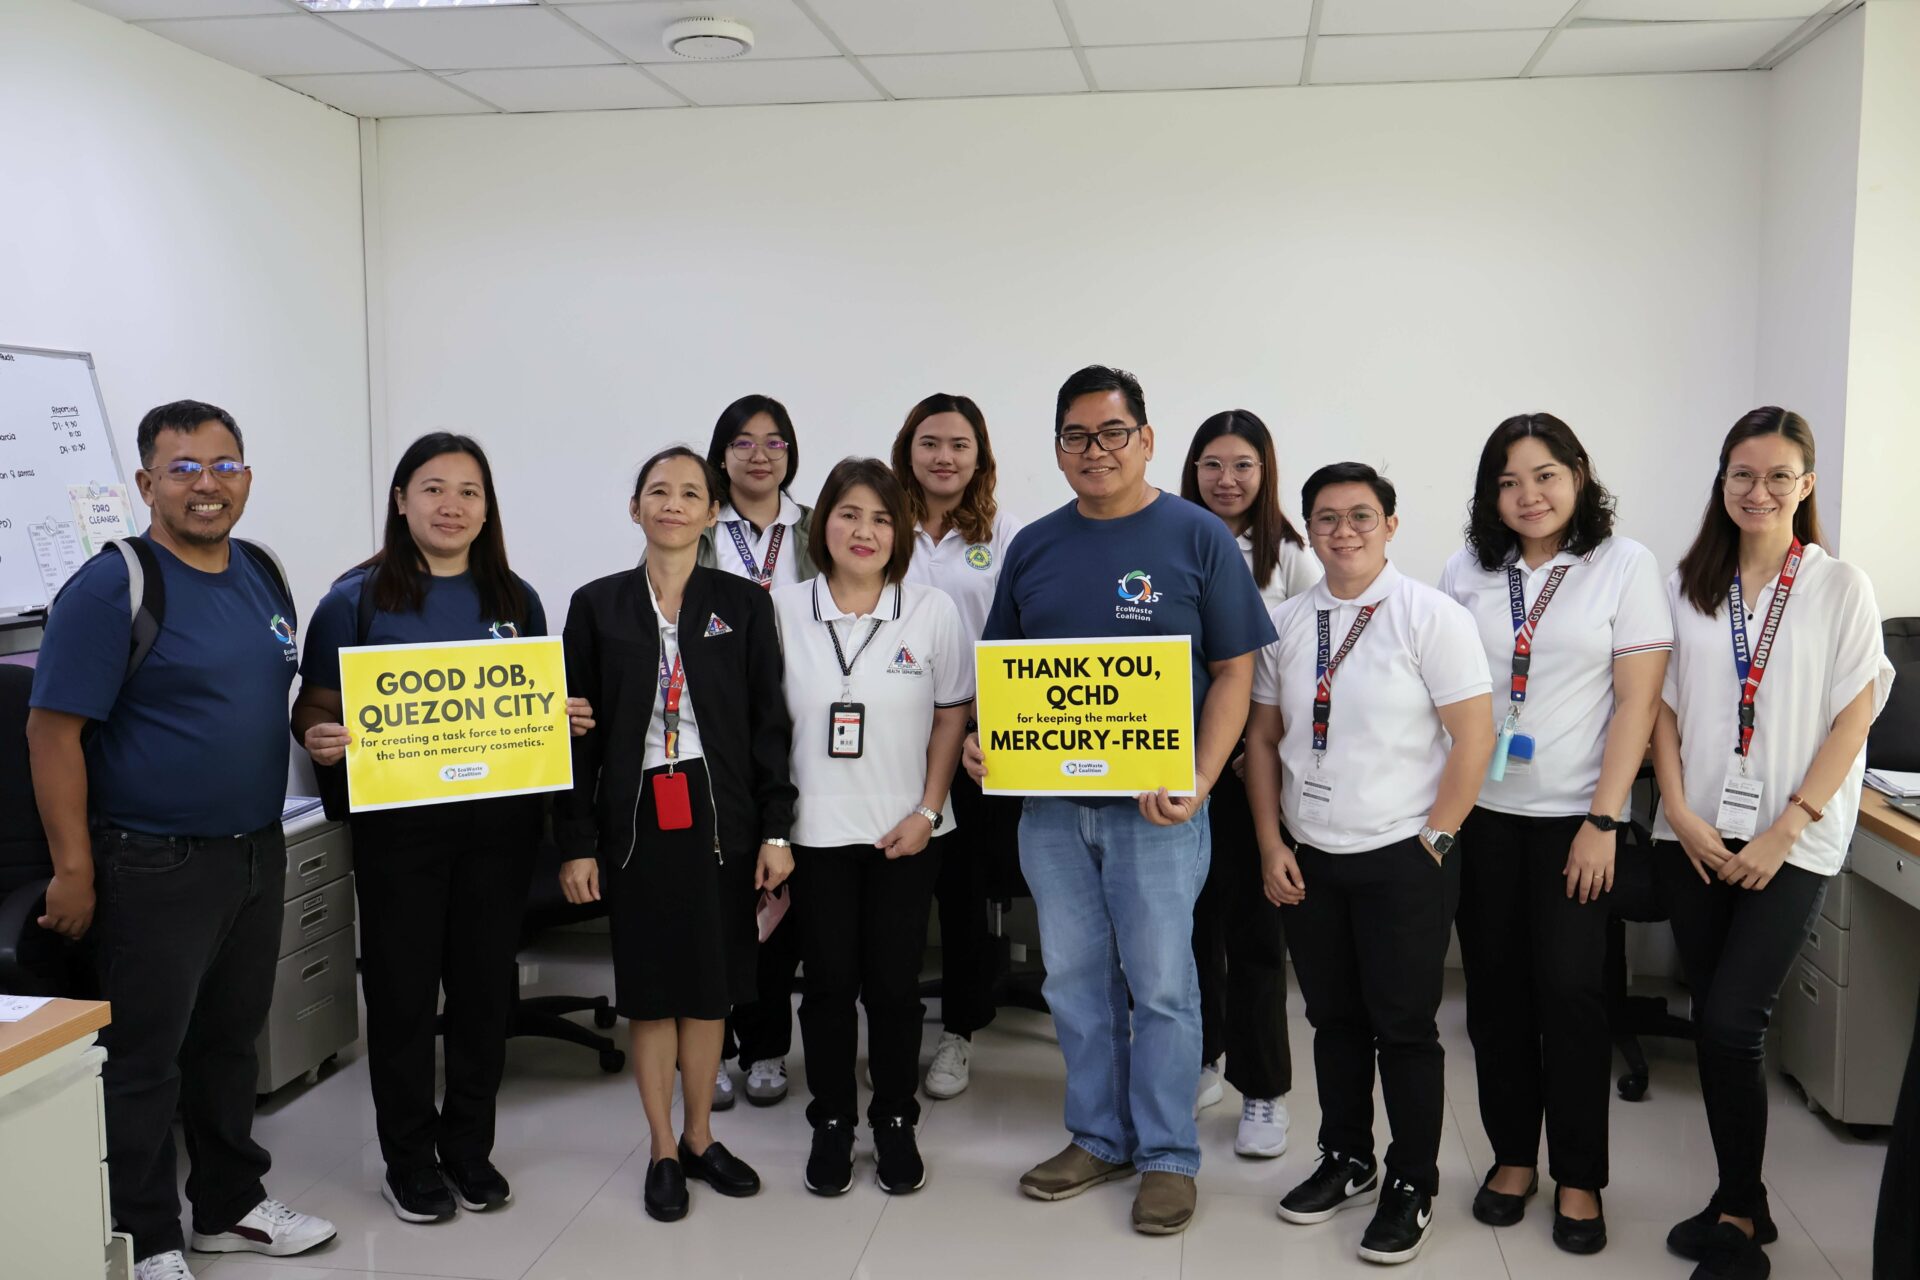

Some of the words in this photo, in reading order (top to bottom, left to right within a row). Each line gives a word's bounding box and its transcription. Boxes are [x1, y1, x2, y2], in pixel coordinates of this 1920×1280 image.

[89, 515, 120, 525] CLEANERS
[730, 527, 751, 561] QUEZON
[1144, 592, 1163, 603] 25
[1530, 566, 1567, 621] GOVERNMEN
[1115, 605, 1153, 615] EcoWaste
[1115, 612, 1151, 621] Coalition
[1512, 601, 1525, 621] CITY
[1729, 584, 1744, 630] QUEZON
[1754, 582, 1790, 669] GOVERNMENT
[1329, 608, 1372, 670] GOVERNMENT
[1735, 633, 1748, 662] CITY
[1003, 657, 1091, 679] THANK
[1097, 656, 1161, 680] YOU,
[1318, 649, 1329, 669] CITY
[376, 668, 466, 696] GOOD
[474, 664, 535, 690] JOB,
[1046, 685, 1119, 710] QCHD
[359, 697, 486, 733] QUEZON
[494, 692, 555, 718] CITY
[1017, 713, 1033, 723] for
[1036, 713, 1082, 725] keeping
[1085, 712, 1103, 723] the
[1106, 712, 1147, 722] market
[361, 737, 379, 748] for
[381, 732, 429, 747] creating
[432, 734, 440, 742] a
[442, 728, 466, 741] task
[469, 728, 497, 739] force
[500, 727, 511, 736] to
[514, 723, 554, 735] enforce
[990, 729, 1180, 751] MERCURY-FREE
[376, 750, 395, 761] the
[398, 748, 420, 759] ban
[423, 748, 438, 757] on
[440, 743, 487, 756] mercury
[490, 738, 545, 751] cosmetics.
